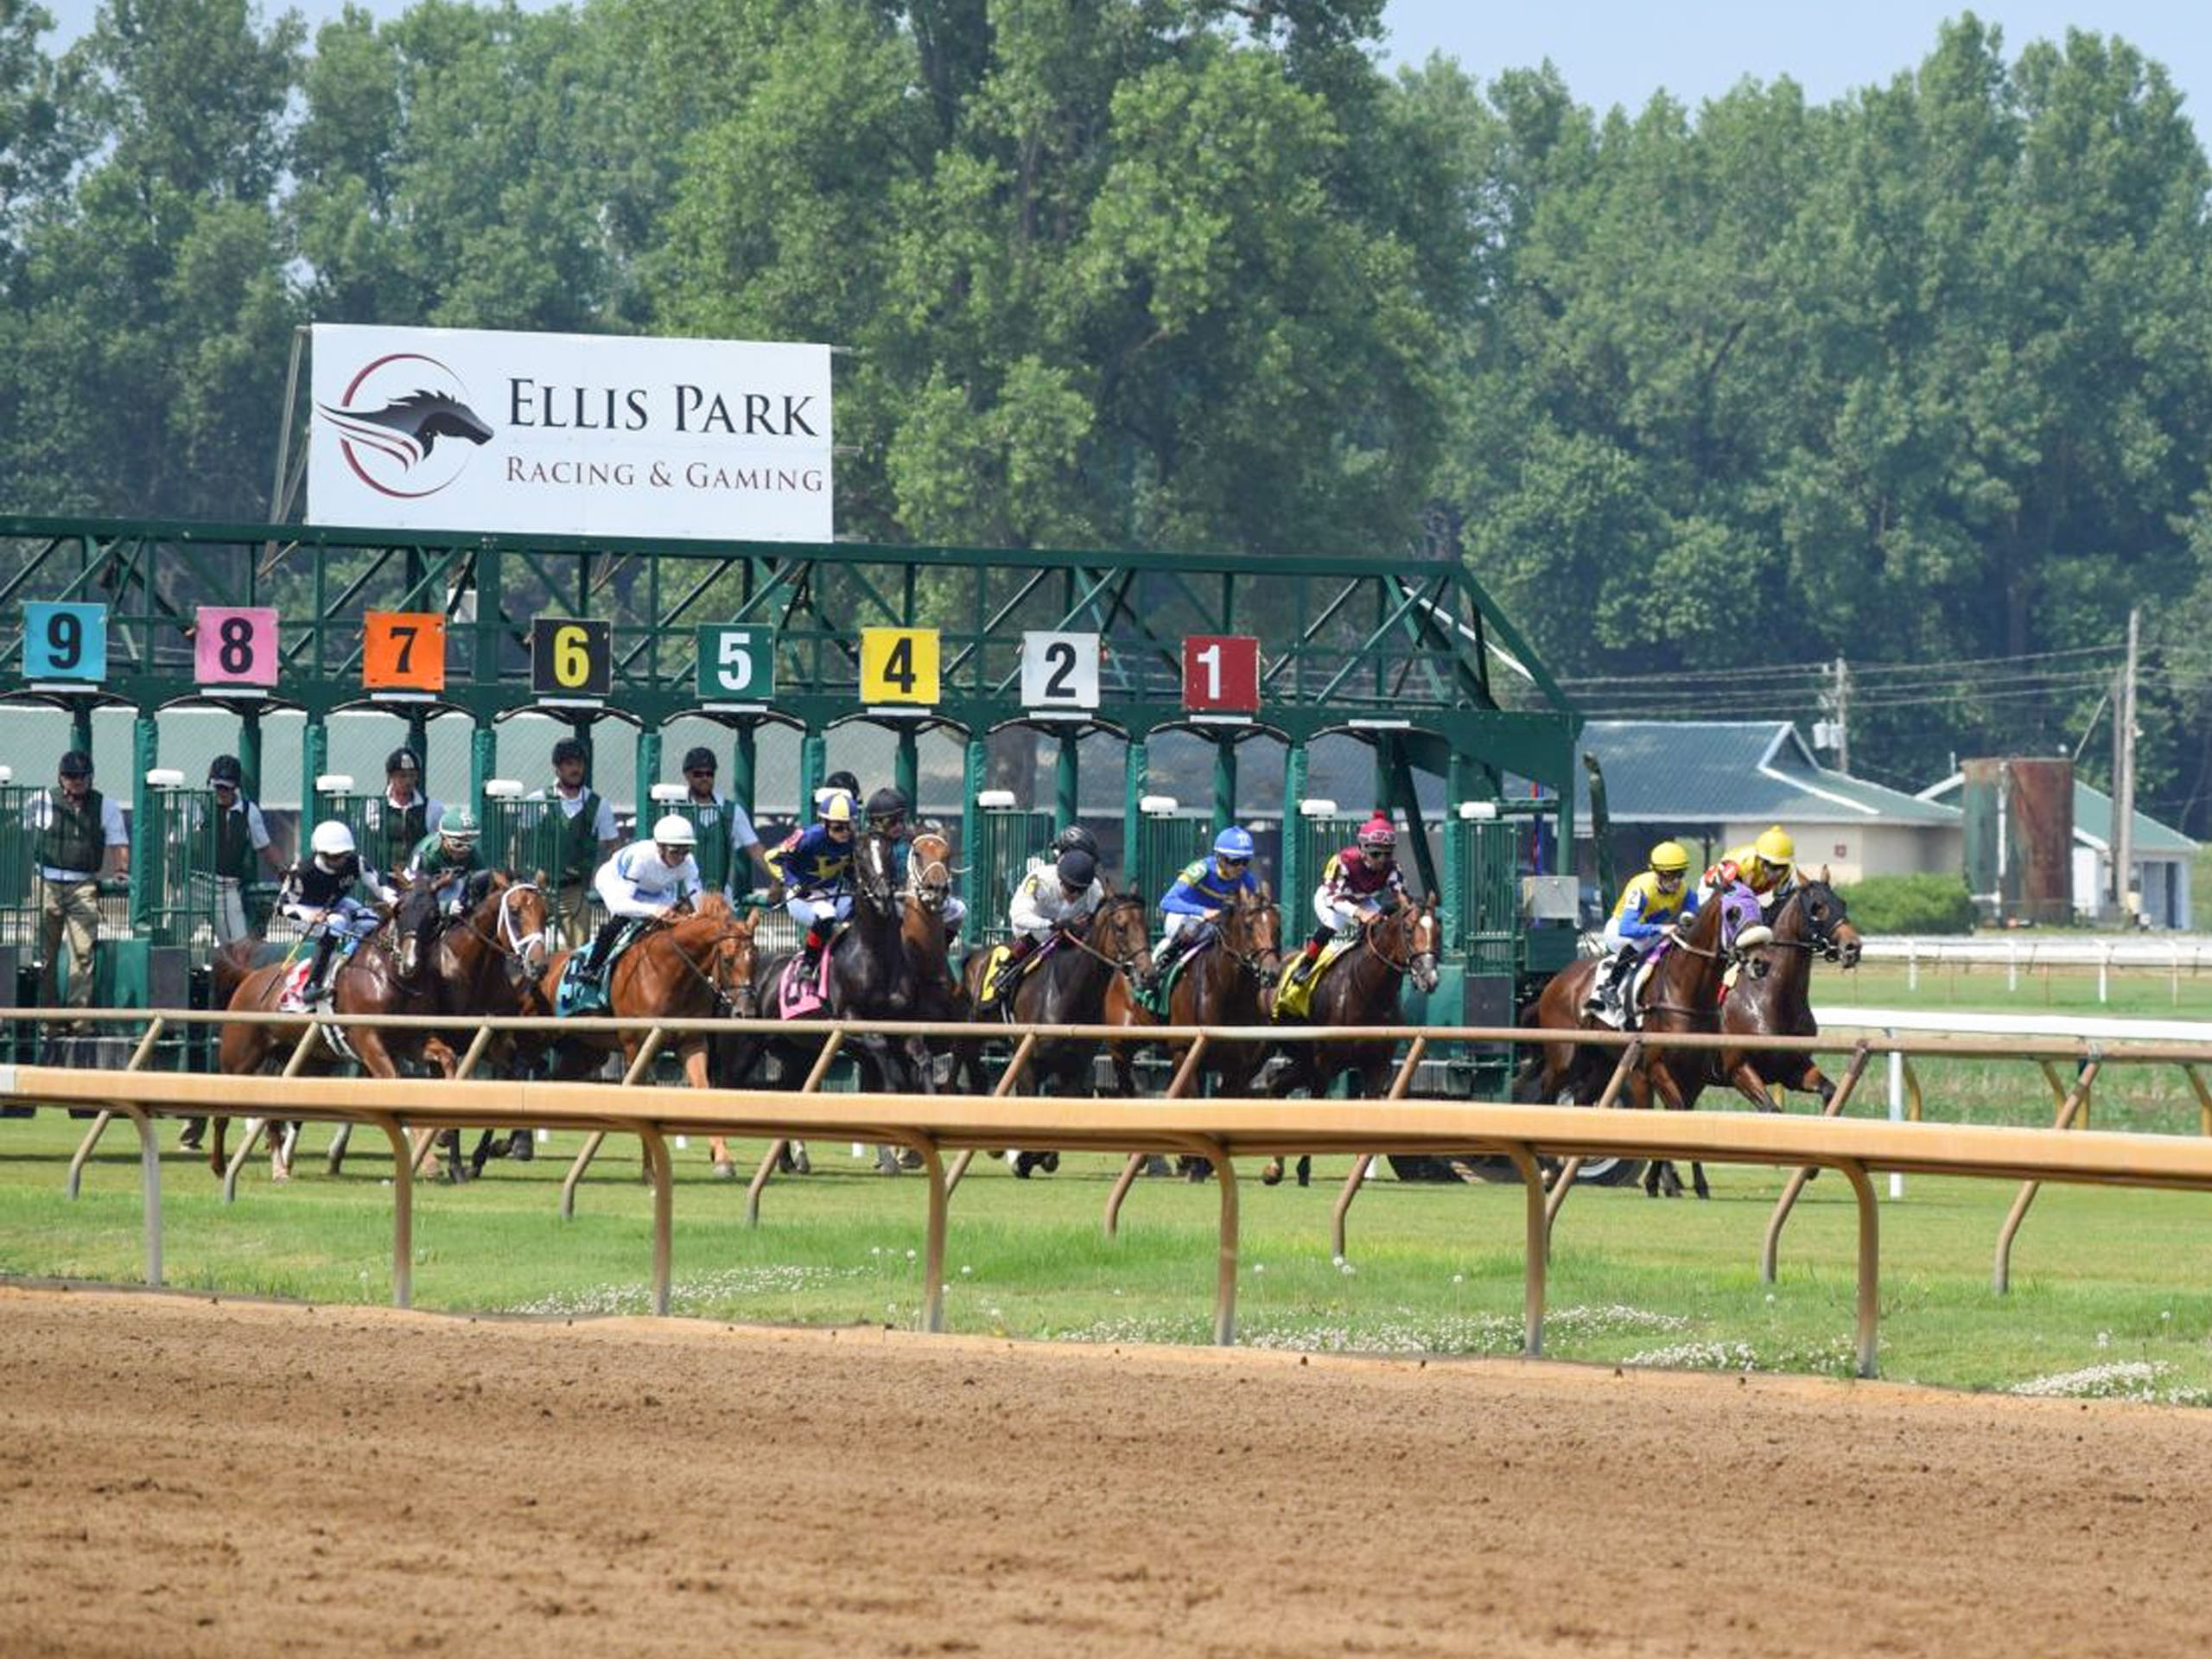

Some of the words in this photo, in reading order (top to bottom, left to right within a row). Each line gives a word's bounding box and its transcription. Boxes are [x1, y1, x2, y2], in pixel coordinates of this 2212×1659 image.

[649, 461, 672, 487] &
[47, 612, 82, 670] 9
[219, 616, 254, 674] 8
[389, 626, 418, 674] 7
[553, 626, 590, 688] 6
[717, 632, 752, 690] 5
[882, 637, 917, 695] 4
[1044, 642, 1077, 698] 2
[1197, 645, 1221, 701] 1
